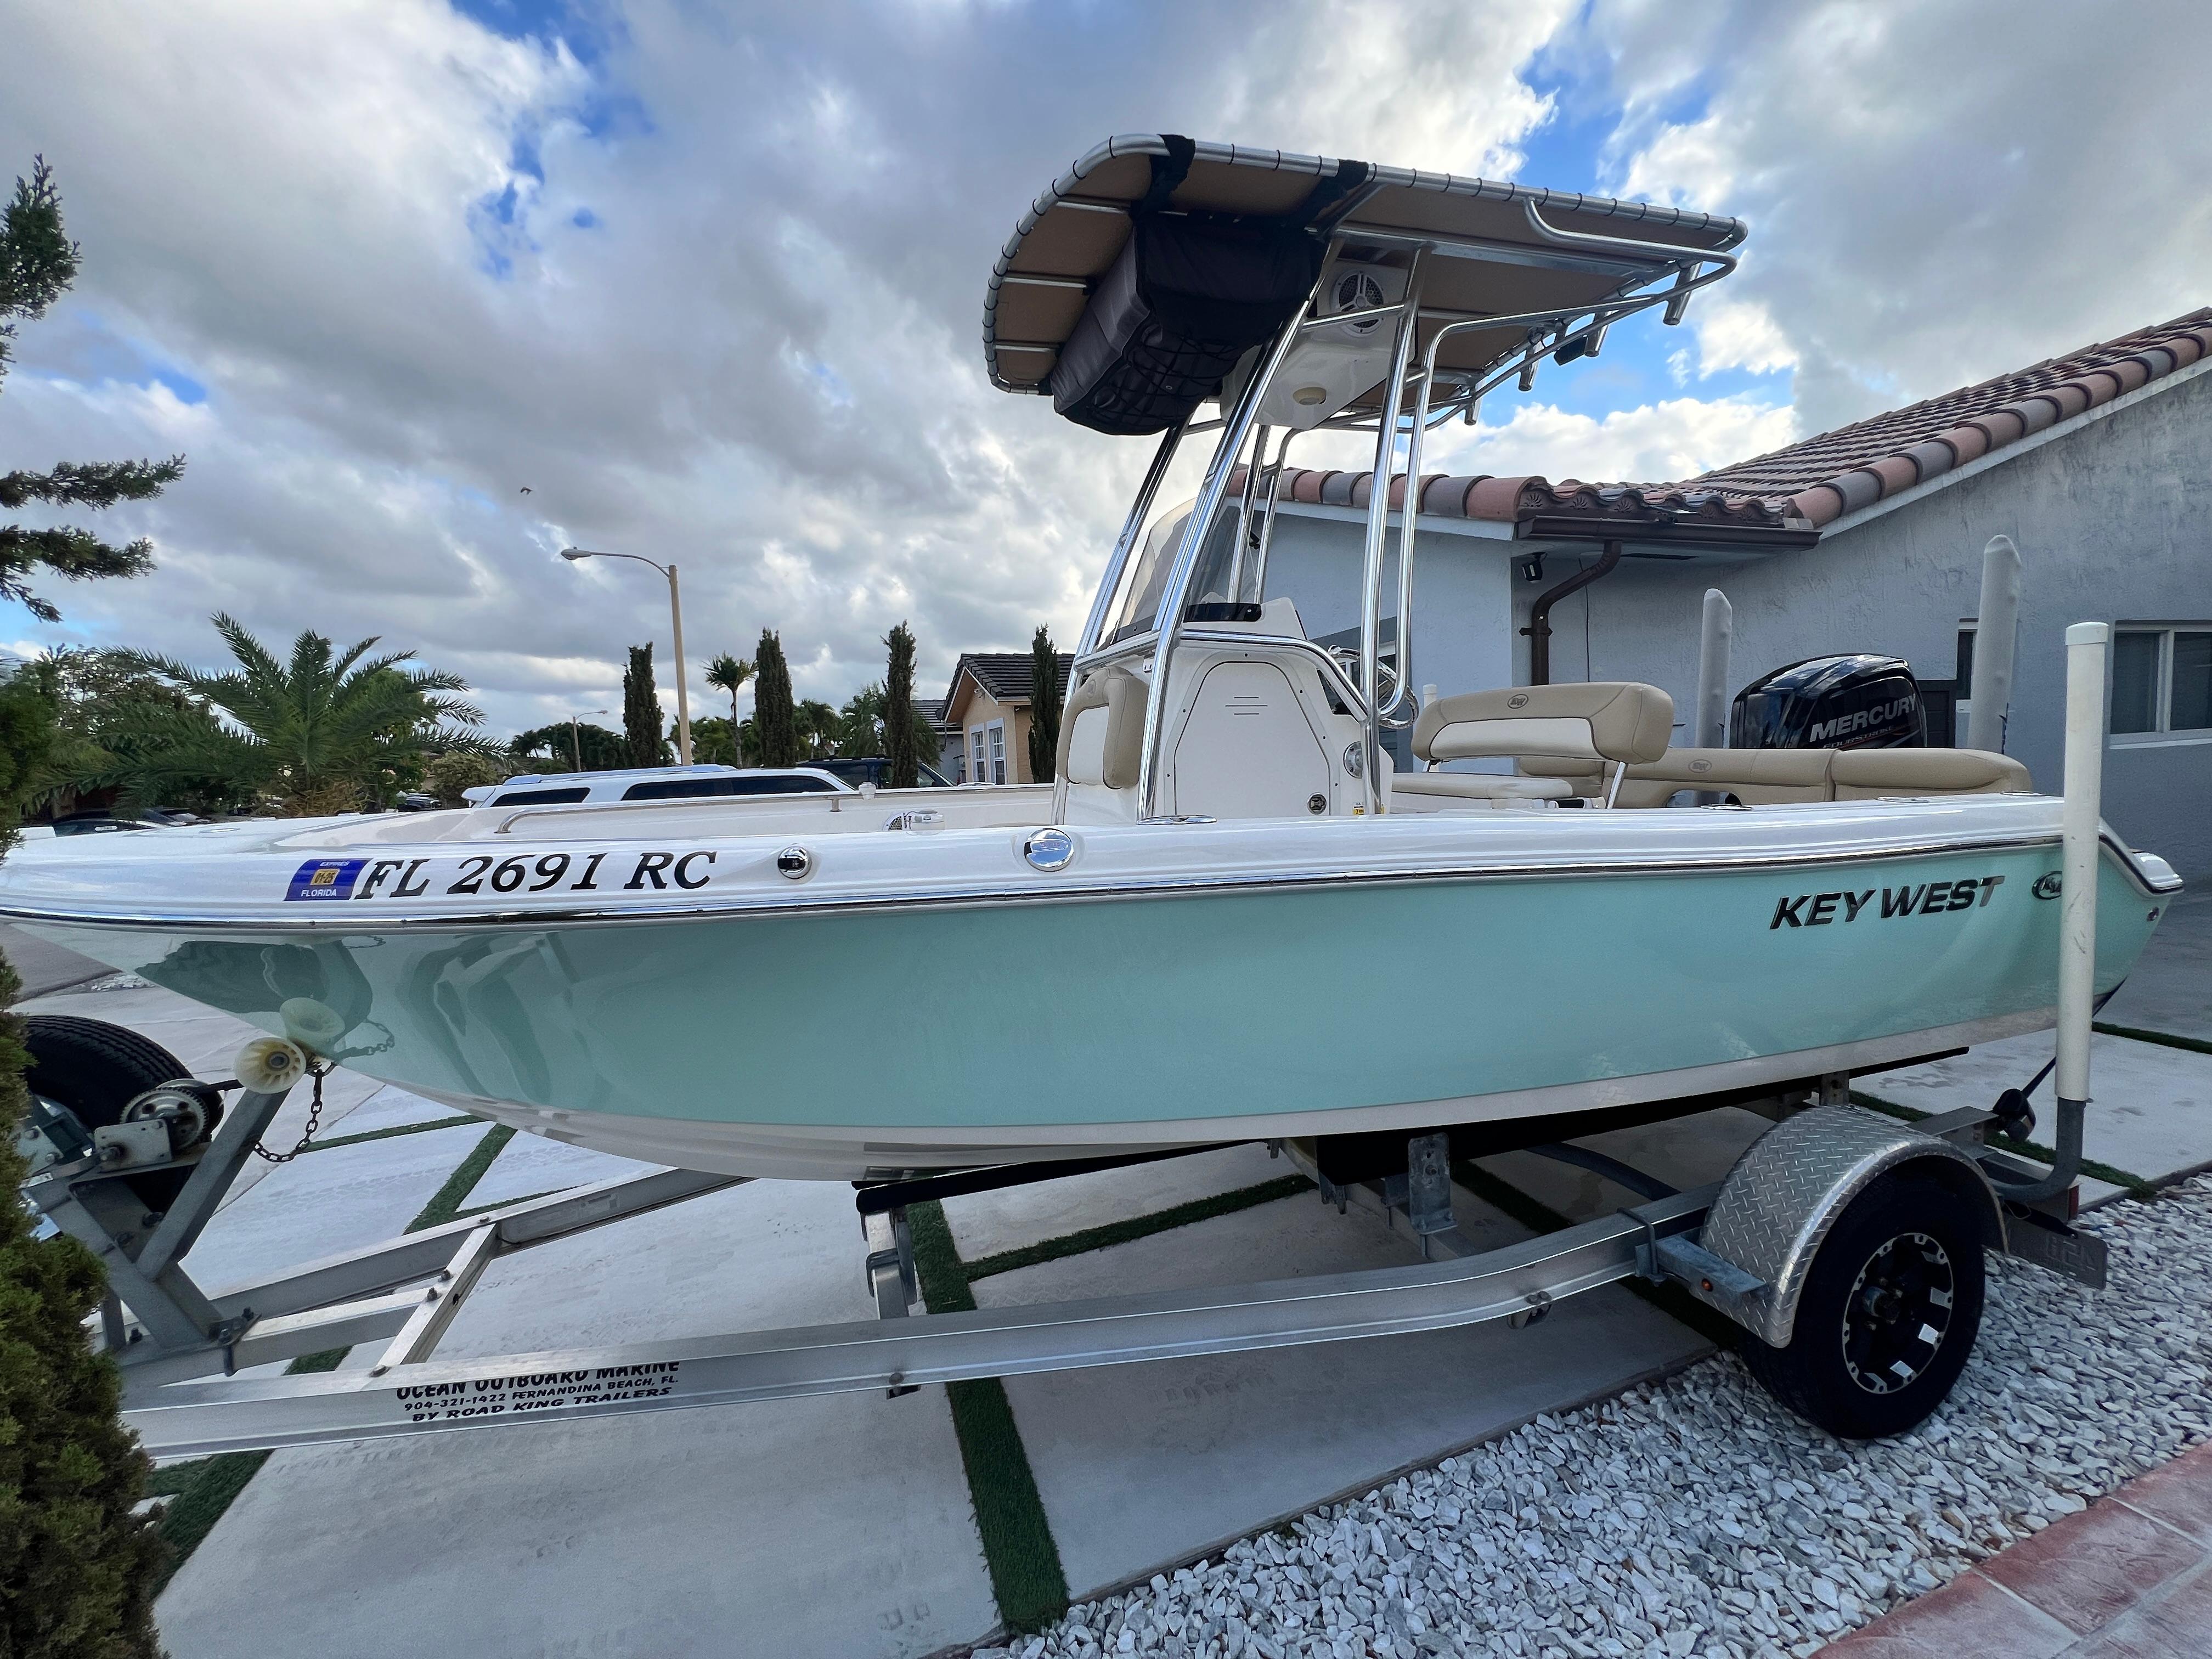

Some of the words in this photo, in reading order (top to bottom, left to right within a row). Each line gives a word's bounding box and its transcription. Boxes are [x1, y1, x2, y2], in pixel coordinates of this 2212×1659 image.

[1810, 693, 1916, 742] MERCURY
[301, 889, 337, 897] FLORIDA
[354, 858, 432, 900] FL
[446, 852, 610, 895] 2691
[623, 851, 718, 890] RC
[1770, 889, 1876, 929] KEY
[1881, 875, 2006, 918] WEST
[397, 1383, 466, 1400] OCEAN
[475, 1370, 589, 1392] OUTBOARD
[596, 1362, 680, 1379] MARINE
[404, 1393, 506, 1411] 904-321-1422
[512, 1384, 601, 1400] FERNANDINA
[607, 1378, 655, 1390] BEACH,
[661, 1375, 678, 1384] FL.
[413, 1412, 439, 1421] BY
[447, 1405, 505, 1418] ROAD
[513, 1398, 564, 1411] KING
[574, 1387, 672, 1404] TRAILERS
